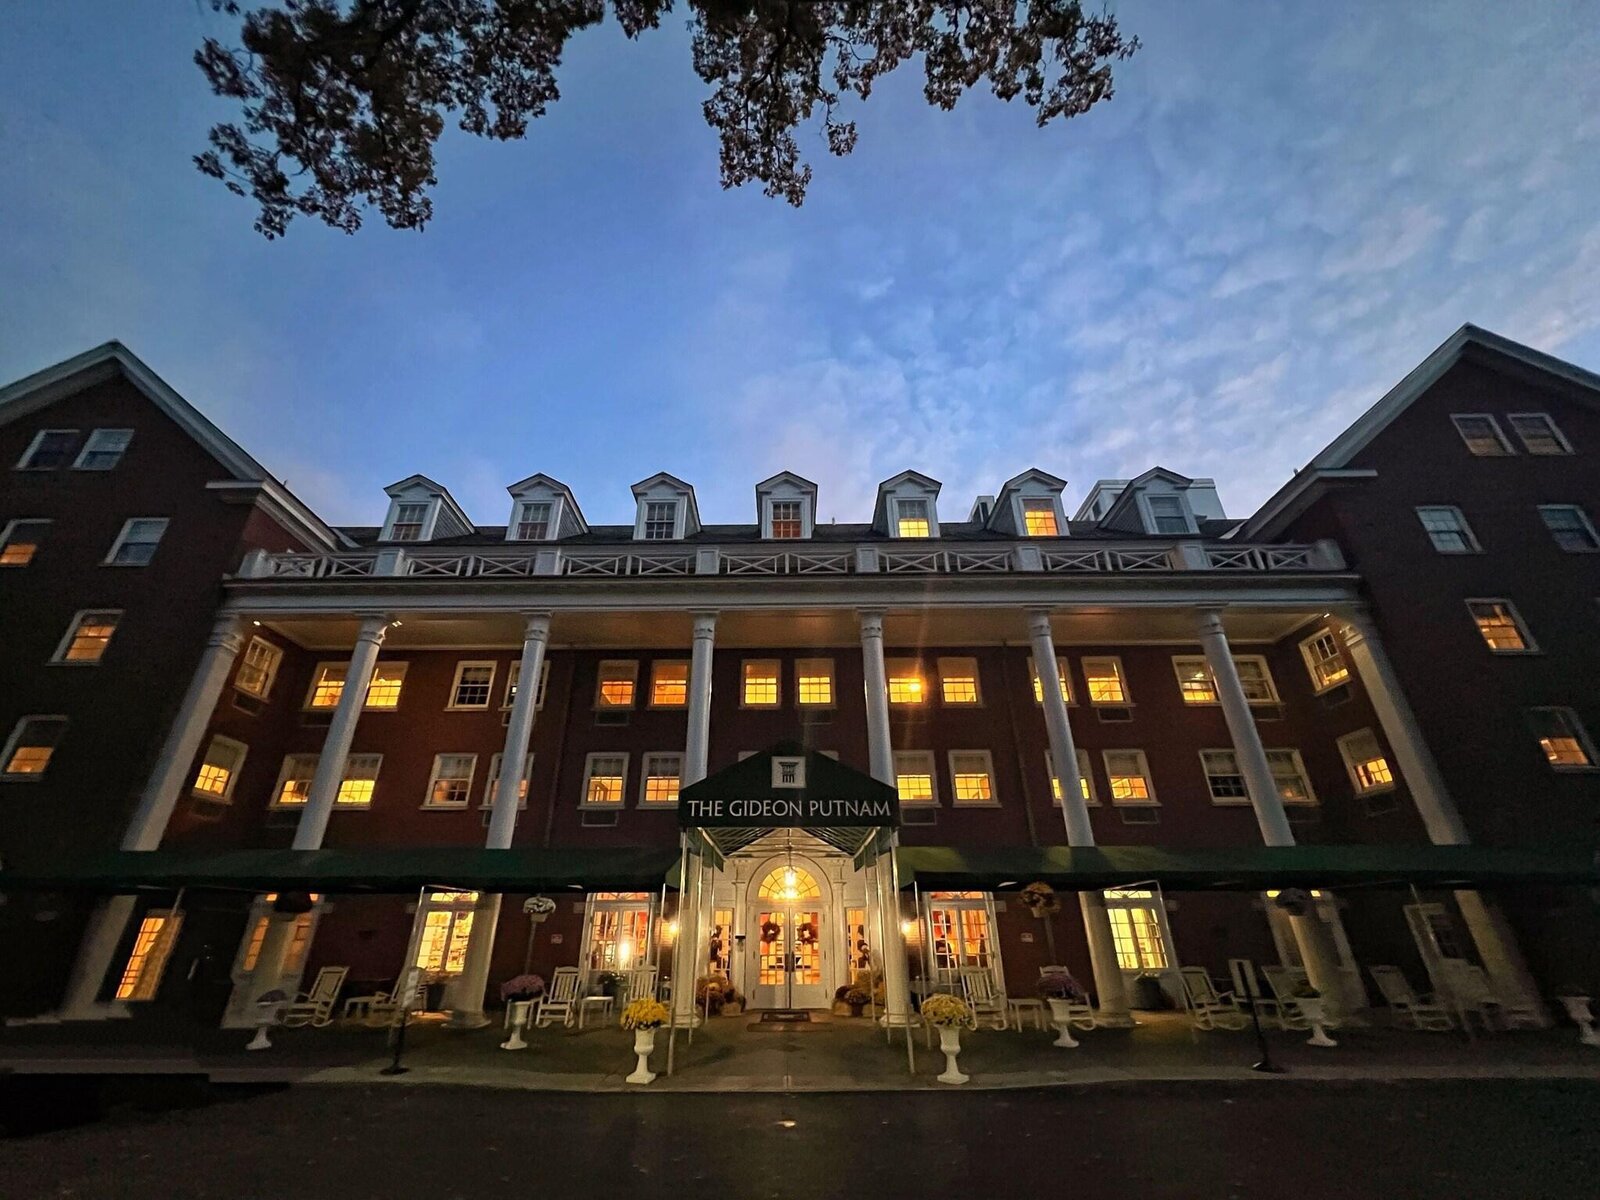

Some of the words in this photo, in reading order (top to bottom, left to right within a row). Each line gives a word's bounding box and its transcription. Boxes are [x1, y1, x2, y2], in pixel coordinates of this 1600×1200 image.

[687, 800, 723, 817] THE
[729, 800, 803, 817] GIDEON
[809, 800, 891, 817] PUTNAM
